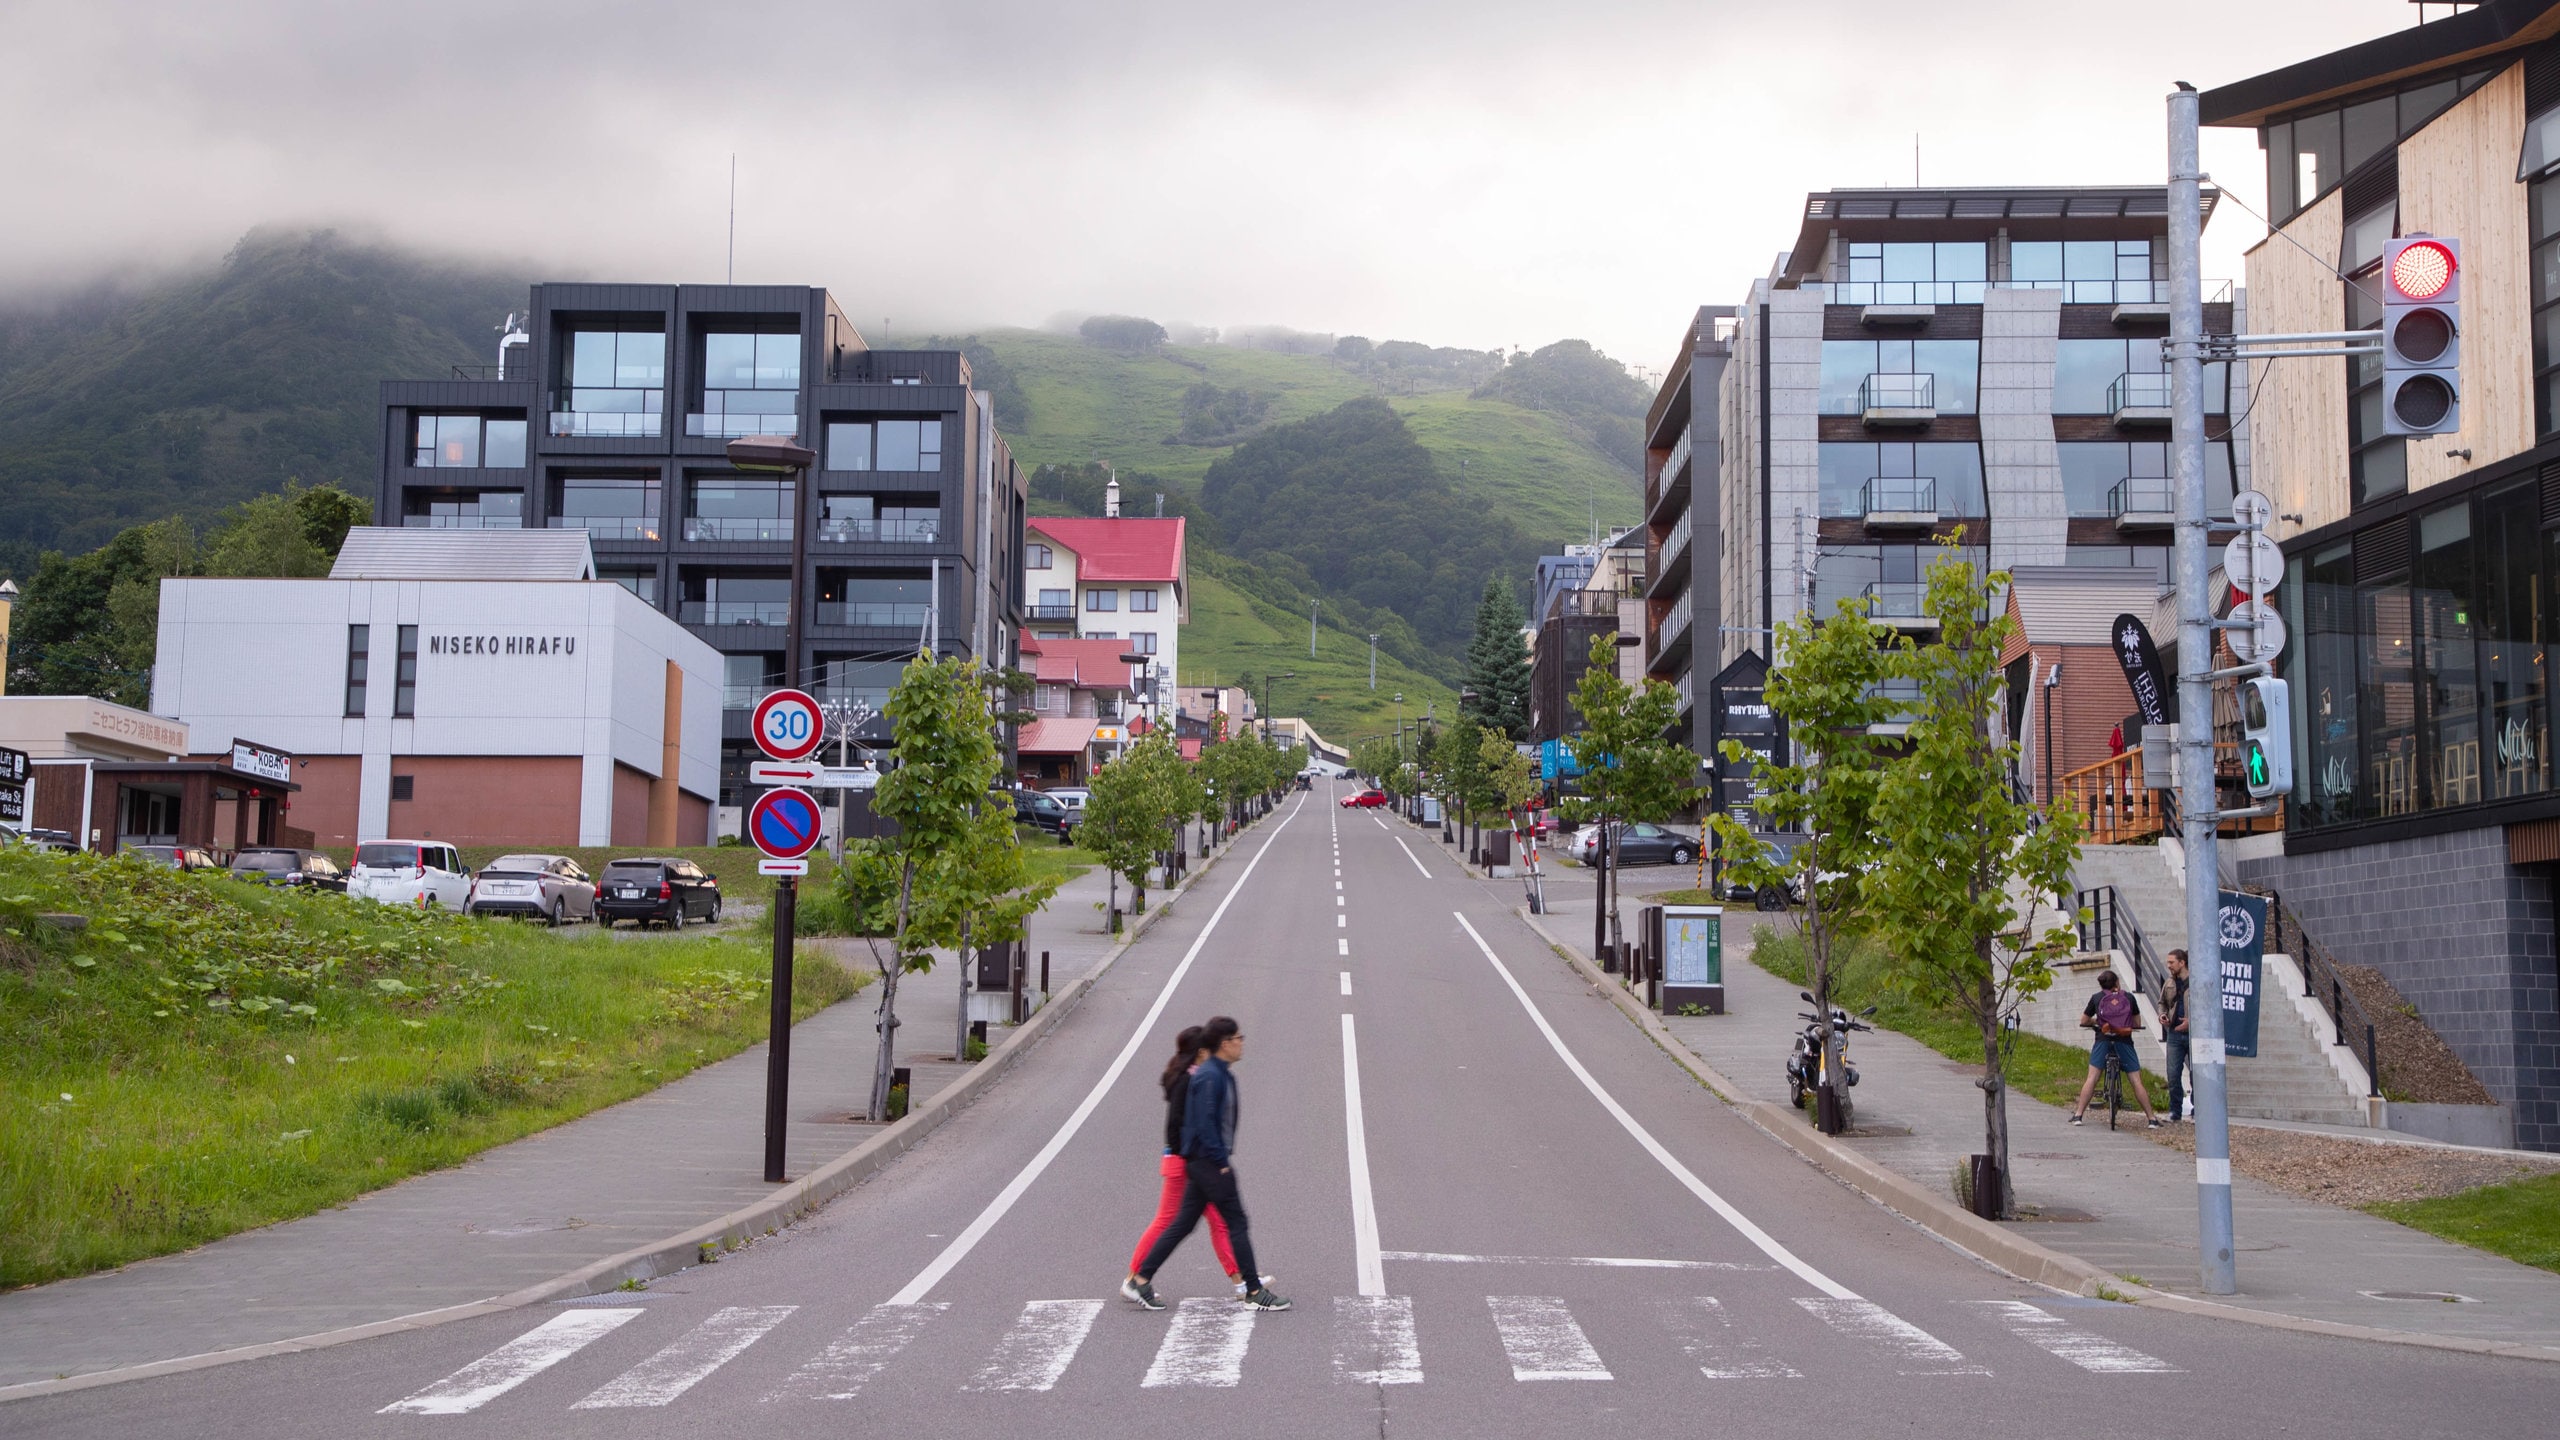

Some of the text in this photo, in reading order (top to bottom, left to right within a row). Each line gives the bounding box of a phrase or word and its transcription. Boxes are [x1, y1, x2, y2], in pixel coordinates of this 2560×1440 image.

[430, 636, 575, 655] NISEKO HIRAFU
[1729, 704, 1769, 715] RHYTHM
[770, 710, 808, 740] 30
[259, 751, 284, 771] KOBAN
[259, 767, 273, 777] POLICE
[2220, 960, 2252, 979] ORTH
[2222, 994, 2246, 1012] EER
